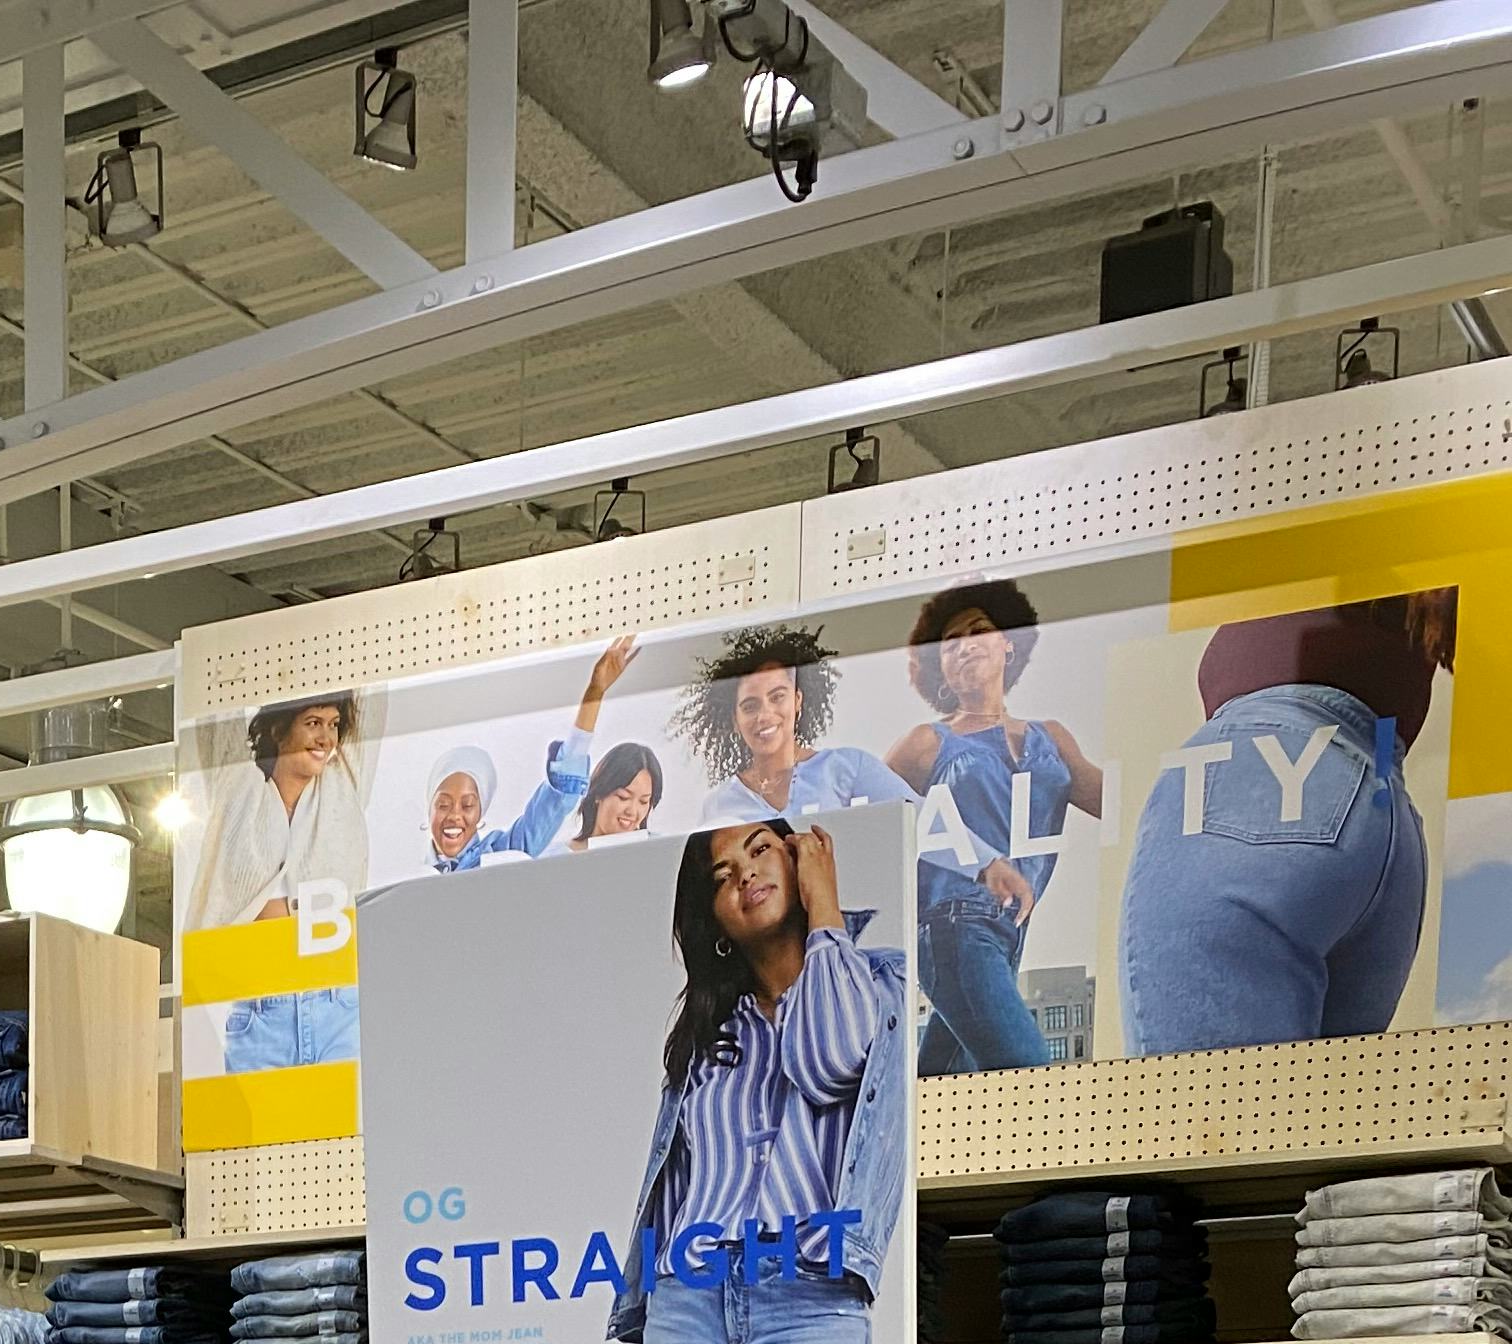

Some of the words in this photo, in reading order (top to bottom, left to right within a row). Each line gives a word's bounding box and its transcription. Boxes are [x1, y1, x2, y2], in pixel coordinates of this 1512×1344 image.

[403, 1188, 466, 1224] OG
[404, 1210, 863, 1311] STRAIGHT
[440, 1333, 464, 1344] THE
[470, 1330, 502, 1342] MOM
[507, 1327, 543, 1340] JEAN
